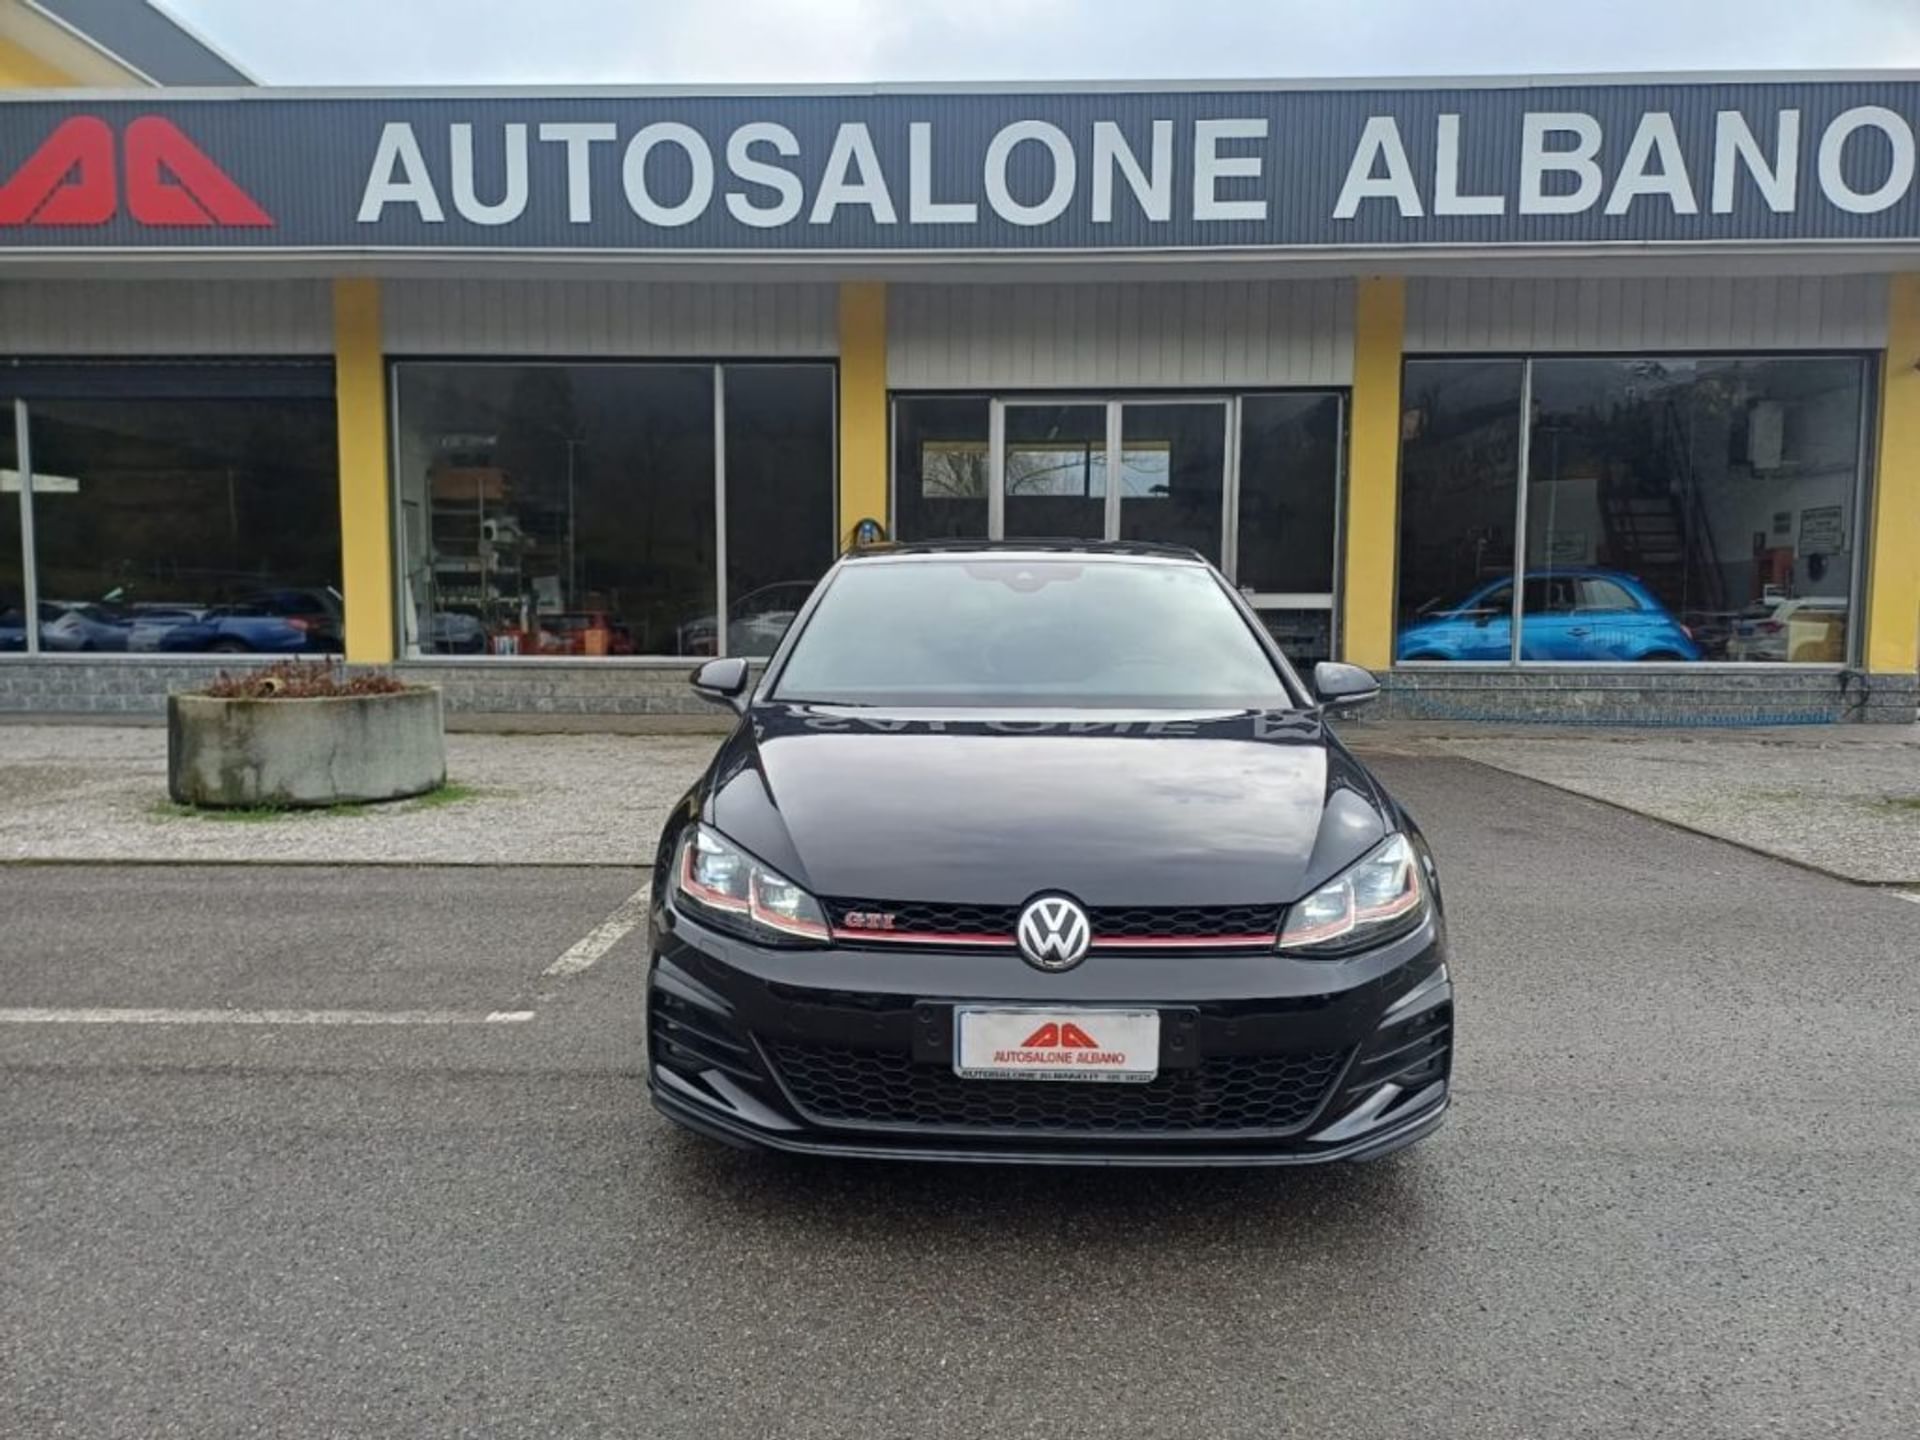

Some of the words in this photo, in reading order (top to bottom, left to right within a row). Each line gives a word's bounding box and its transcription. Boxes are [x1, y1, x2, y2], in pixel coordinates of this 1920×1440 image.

[356, 118, 1268, 227] AUTOSALONE
[1332, 105, 1916, 218] ALBANO
[845, 911, 896, 930] GTI
[993, 1051, 1073, 1064] AUTOSALONE
[1076, 1052, 1126, 1065] ALBANO
